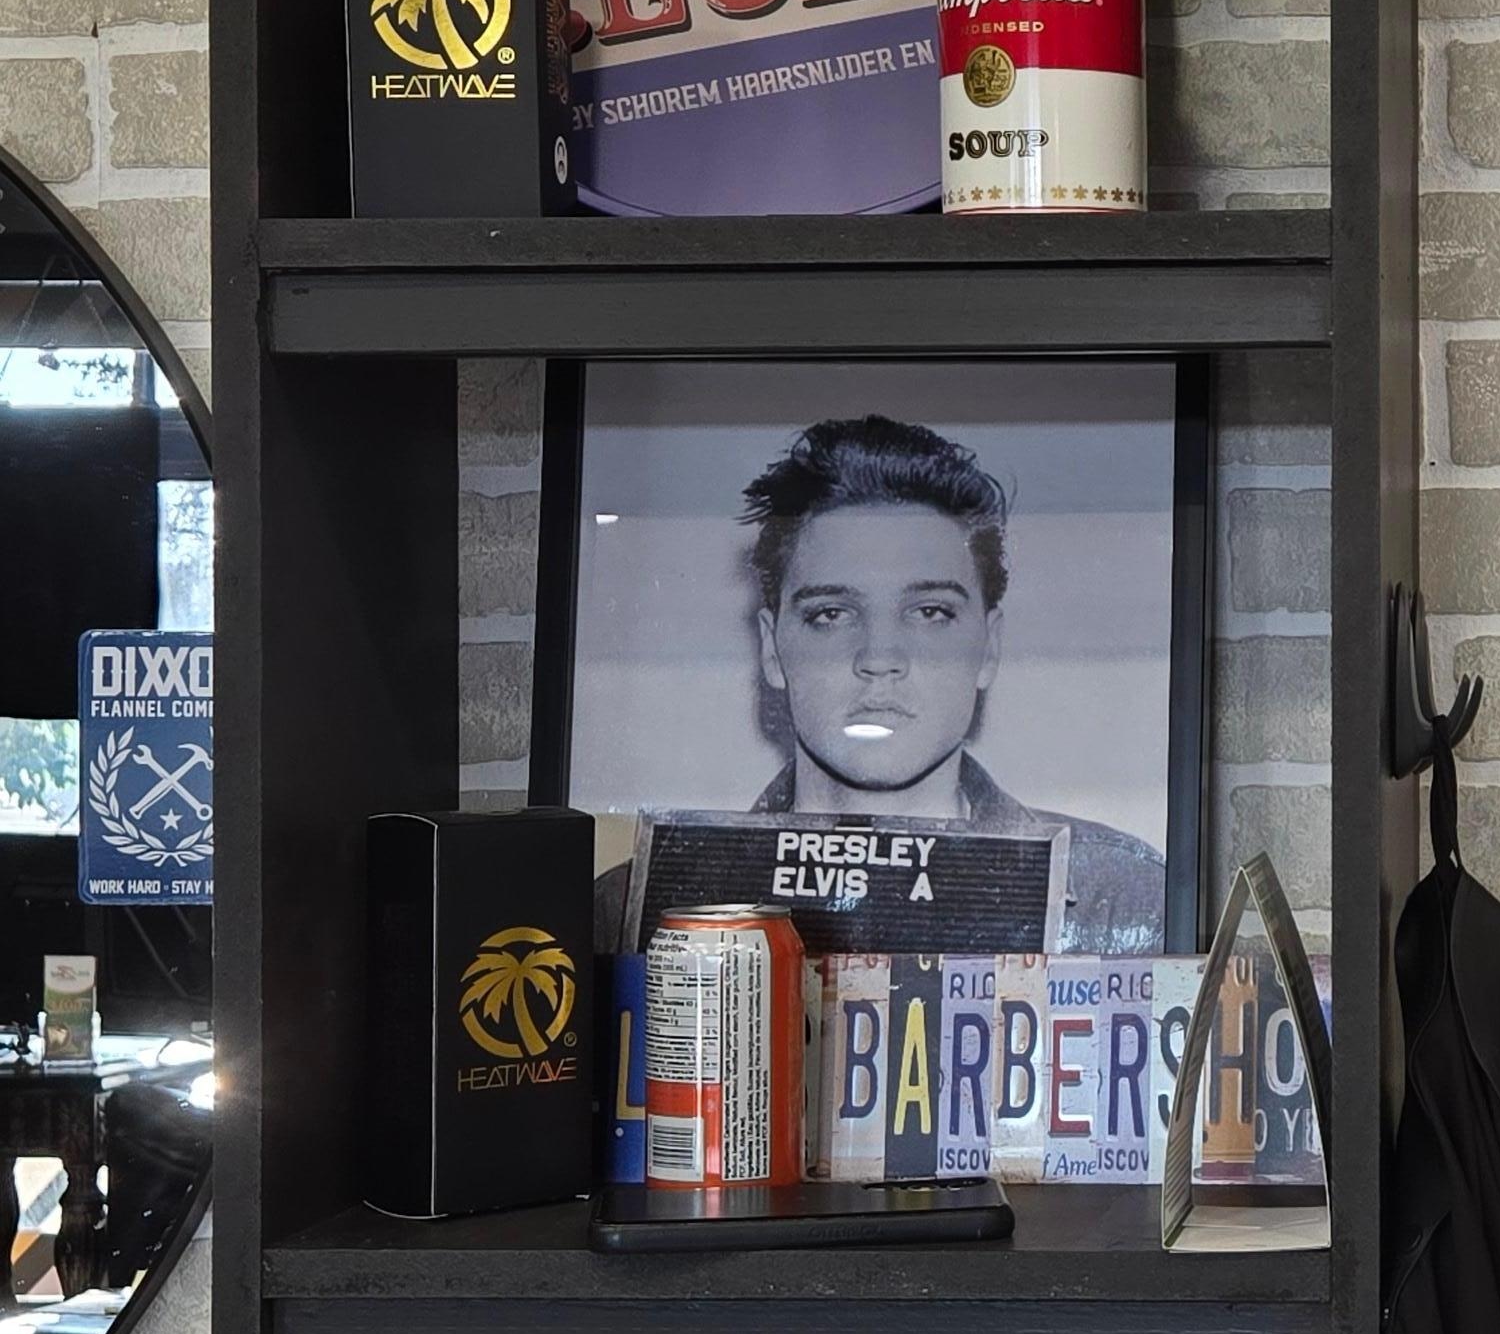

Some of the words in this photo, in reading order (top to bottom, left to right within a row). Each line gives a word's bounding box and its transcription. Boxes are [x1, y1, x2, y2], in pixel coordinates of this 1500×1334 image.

[963, 21, 1045, 34] DENSED
[371, 73, 517, 99] HEATWAVE
[601, 80, 722, 126] SCHOREM
[727, 47, 896, 103] HAARSNIJDER
[900, 39, 936, 69] EN
[949, 129, 1049, 161] SOUP
[91, 646, 214, 698] DIXXO
[91, 700, 166, 718] FLANNEL
[172, 700, 214, 718] COM
[776, 832, 936, 867] PRESLEY
[89, 879, 125, 895] WORK
[128, 879, 161, 895] HARD
[171, 879, 201, 895] STAY
[772, 866, 868, 898] ELVIS
[909, 872, 934, 901] A
[457, 1057, 577, 1092] HEATWAVE
